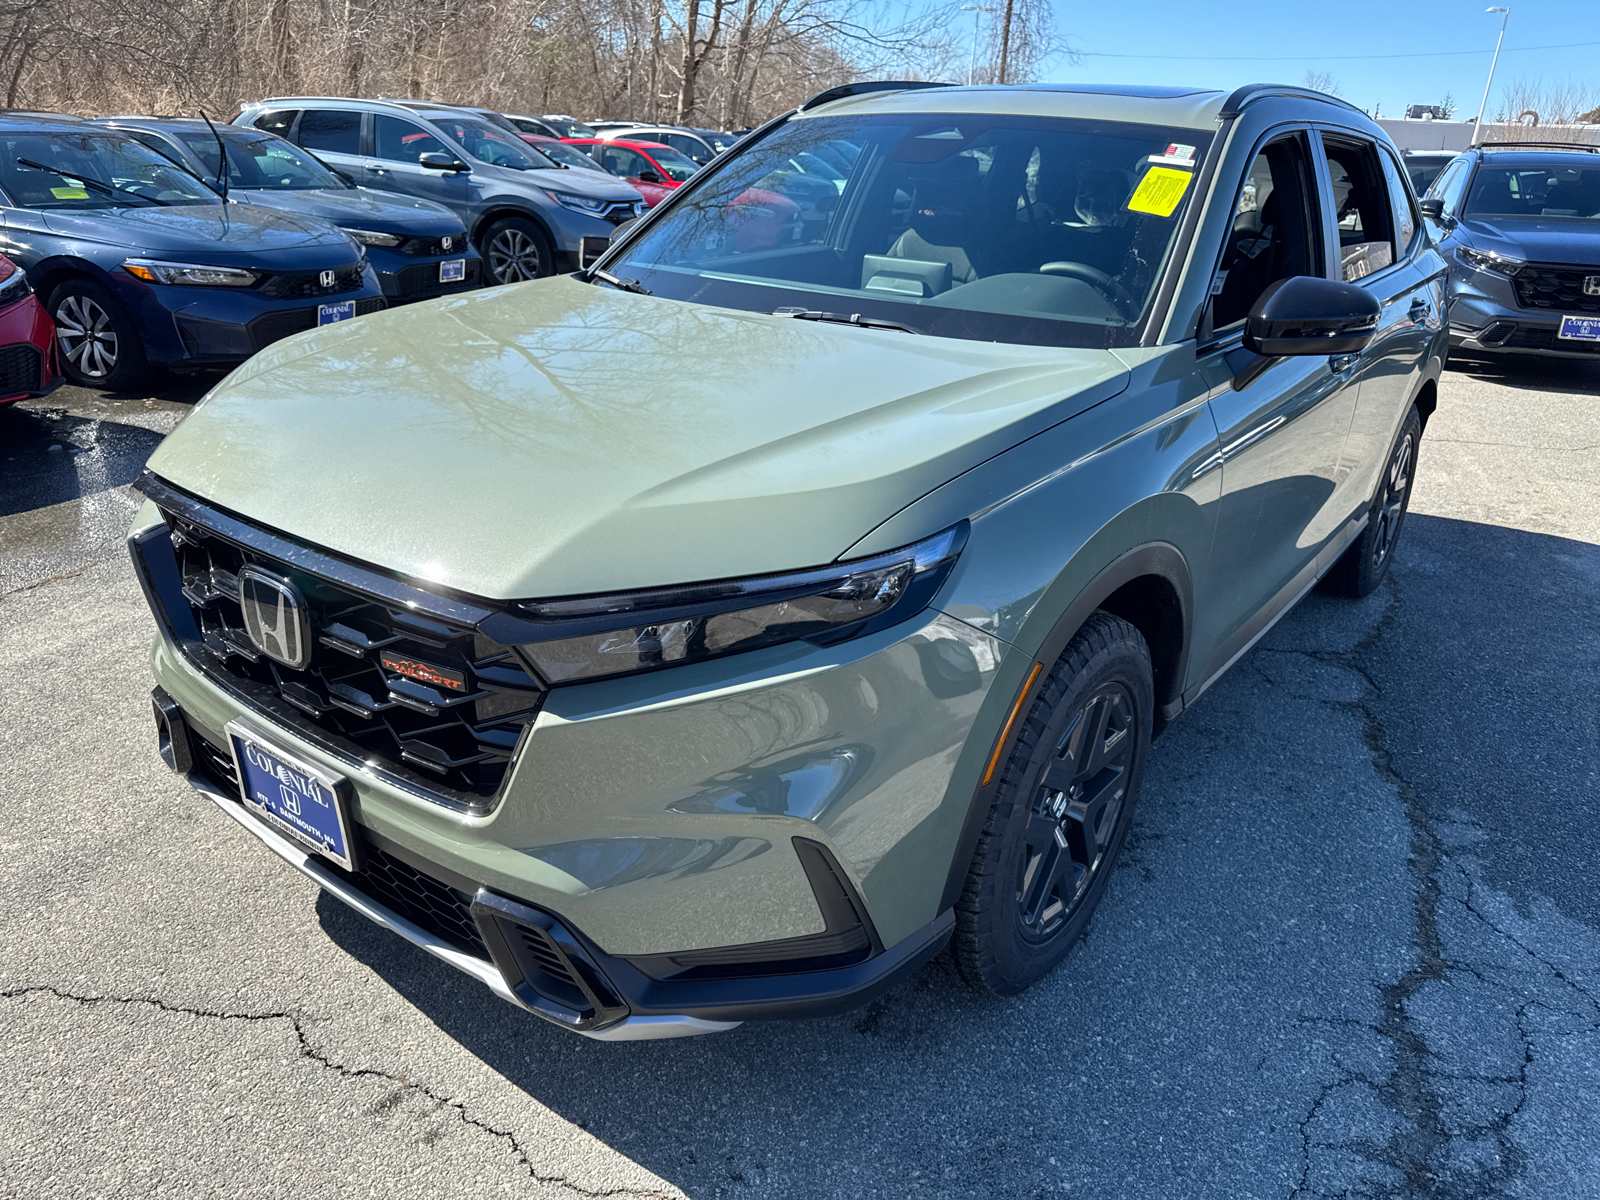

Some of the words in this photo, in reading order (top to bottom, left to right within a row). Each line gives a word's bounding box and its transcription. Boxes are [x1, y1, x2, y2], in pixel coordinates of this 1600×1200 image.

[1568, 320, 1600, 328] COLONIA
[382, 659, 462, 688] TRAILSPORT
[246, 744, 329, 808] COLONIAL
[279, 807, 323, 840] DARTMOUTH,
[323, 833, 336, 847] MA
